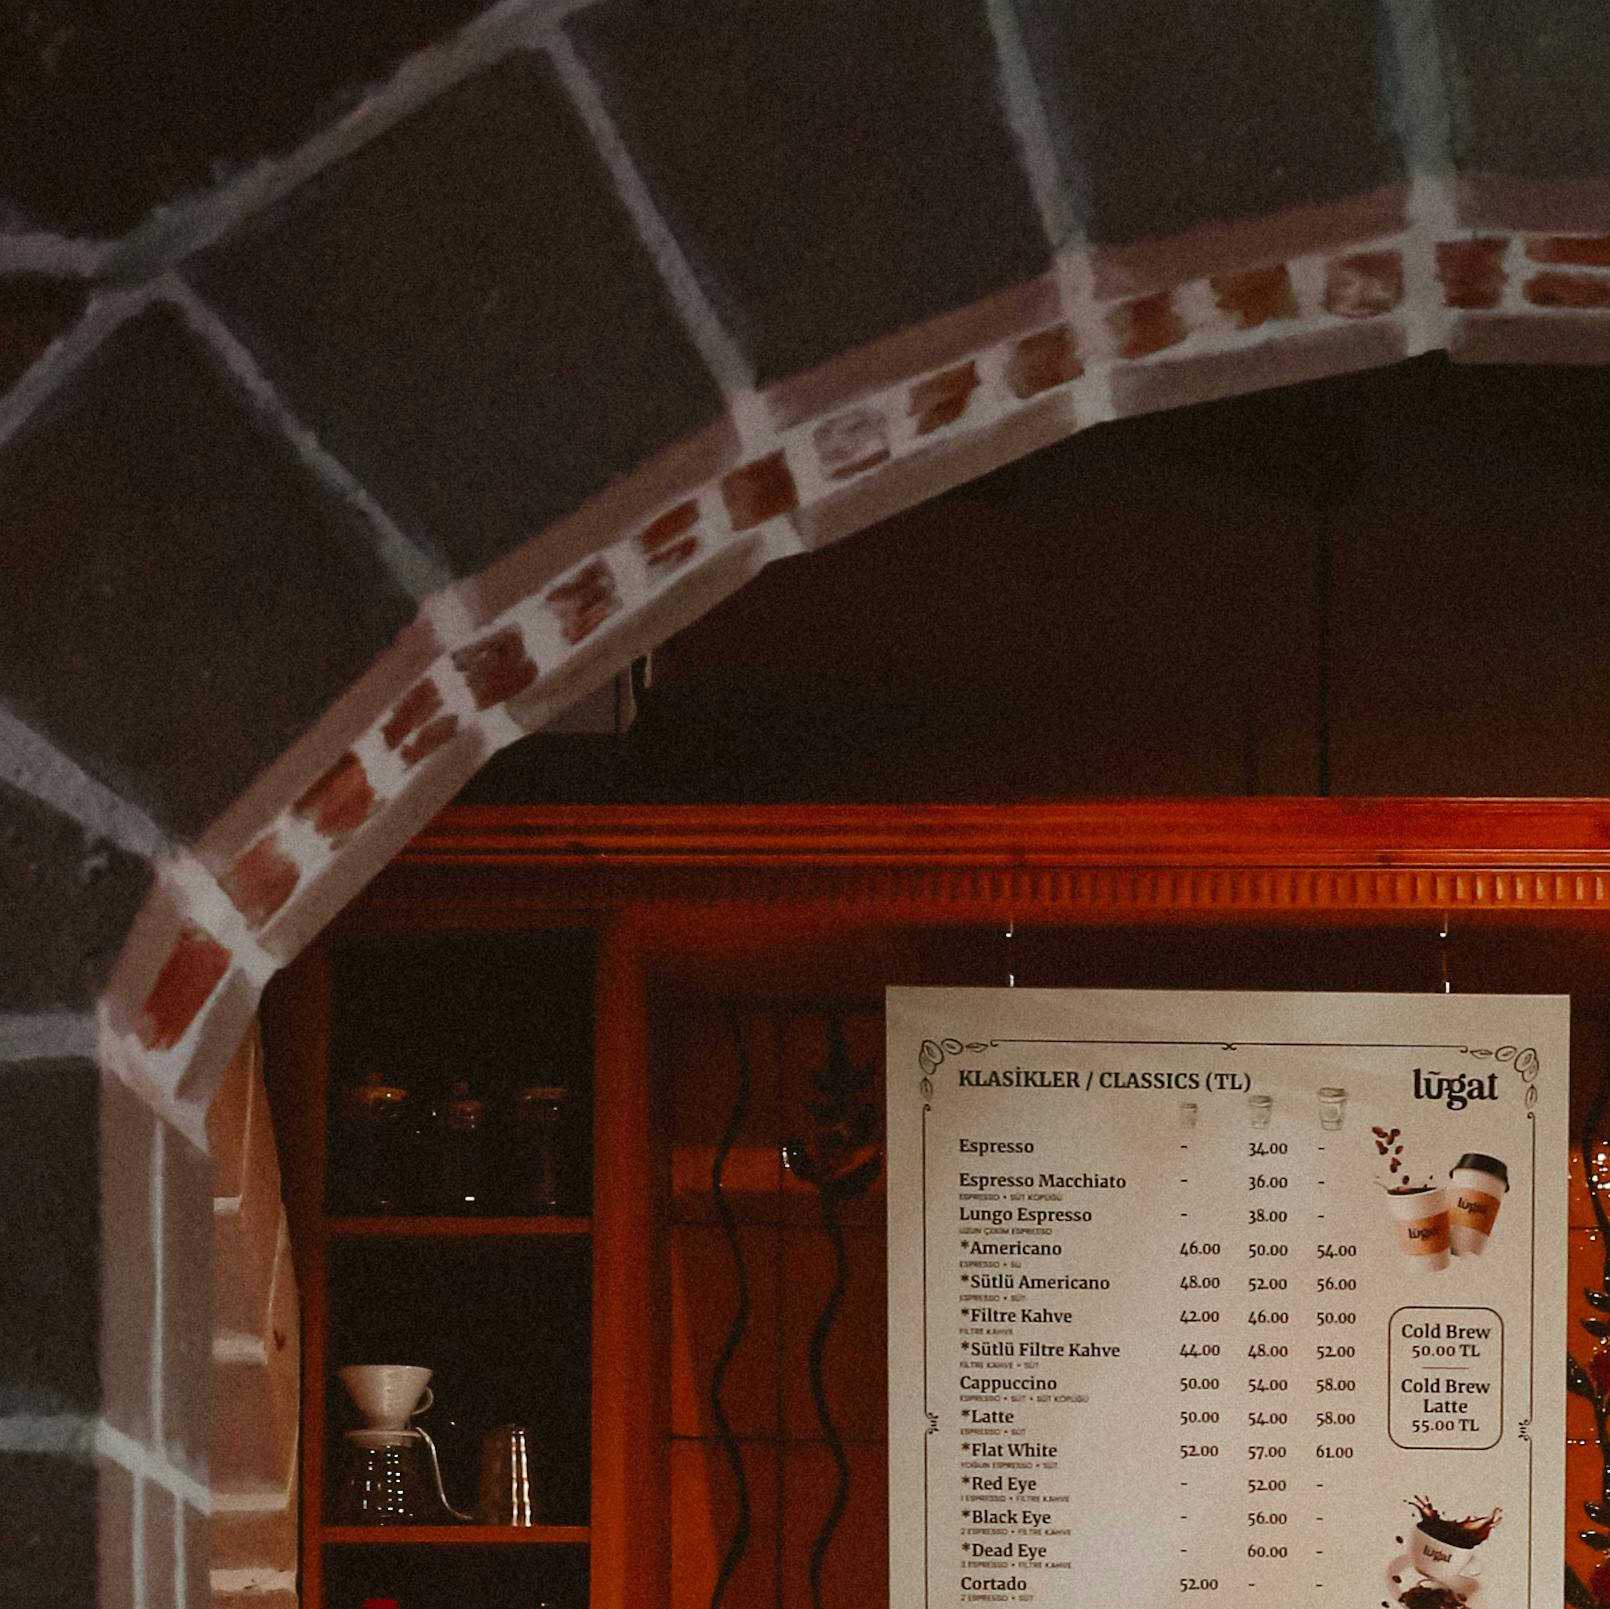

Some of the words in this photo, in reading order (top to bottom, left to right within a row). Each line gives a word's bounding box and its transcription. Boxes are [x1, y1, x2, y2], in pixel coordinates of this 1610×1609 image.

[959, 1066, 1080, 1088] KLASİKLER
[1099, 1072, 1200, 1089] CLASSICS
[1206, 1072, 1251, 1093] (TL)
[959, 1139, 1034, 1157] Espresso
[1249, 1142, 1288, 1157] 34.00
[960, 1173, 1034, 1191] Espresso
[1039, 1173, 1126, 1188] Macchiato
[1249, 1174, 1288, 1191] 36.00
[960, 1207, 1013, 1225] Lungo
[1017, 1207, 1092, 1225] Espresso
[1248, 1208, 1288, 1224] 38.00
[1180, 1241, 1221, 1256] 46.00
[1018, 1275, 1110, 1290] Americano
[1180, 1275, 1220, 1290] 48.00
[1021, 1308, 1072, 1323] Kahve
[1402, 1323, 1441, 1339] Cold
[1446, 1324, 1491, 1339] Brew
[1019, 1342, 1064, 1357] Filtre
[1068, 1342, 1120, 1357] Kahve
[1412, 1345, 1456, 1358] 50.00
[1459, 1344, 1480, 1357] TL
[960, 1376, 1057, 1392] Cappuccino
[1401, 1378, 1440, 1393] Cold
[1445, 1379, 1490, 1394] Brew
[1424, 1399, 1468, 1414] Latte
[1412, 1420, 1454, 1433] 55.00
[1458, 1419, 1479, 1431] TL
[1007, 1443, 1058, 1457] White
[1008, 1477, 1037, 1494] Eye
[1022, 1510, 1051, 1527] Eye
[1018, 1544, 1047, 1560] Eye
[1248, 1544, 1288, 1558] 60.00
[961, 1576, 1027, 1591] Cortado
[1180, 1578, 1218, 1592] 52.00
